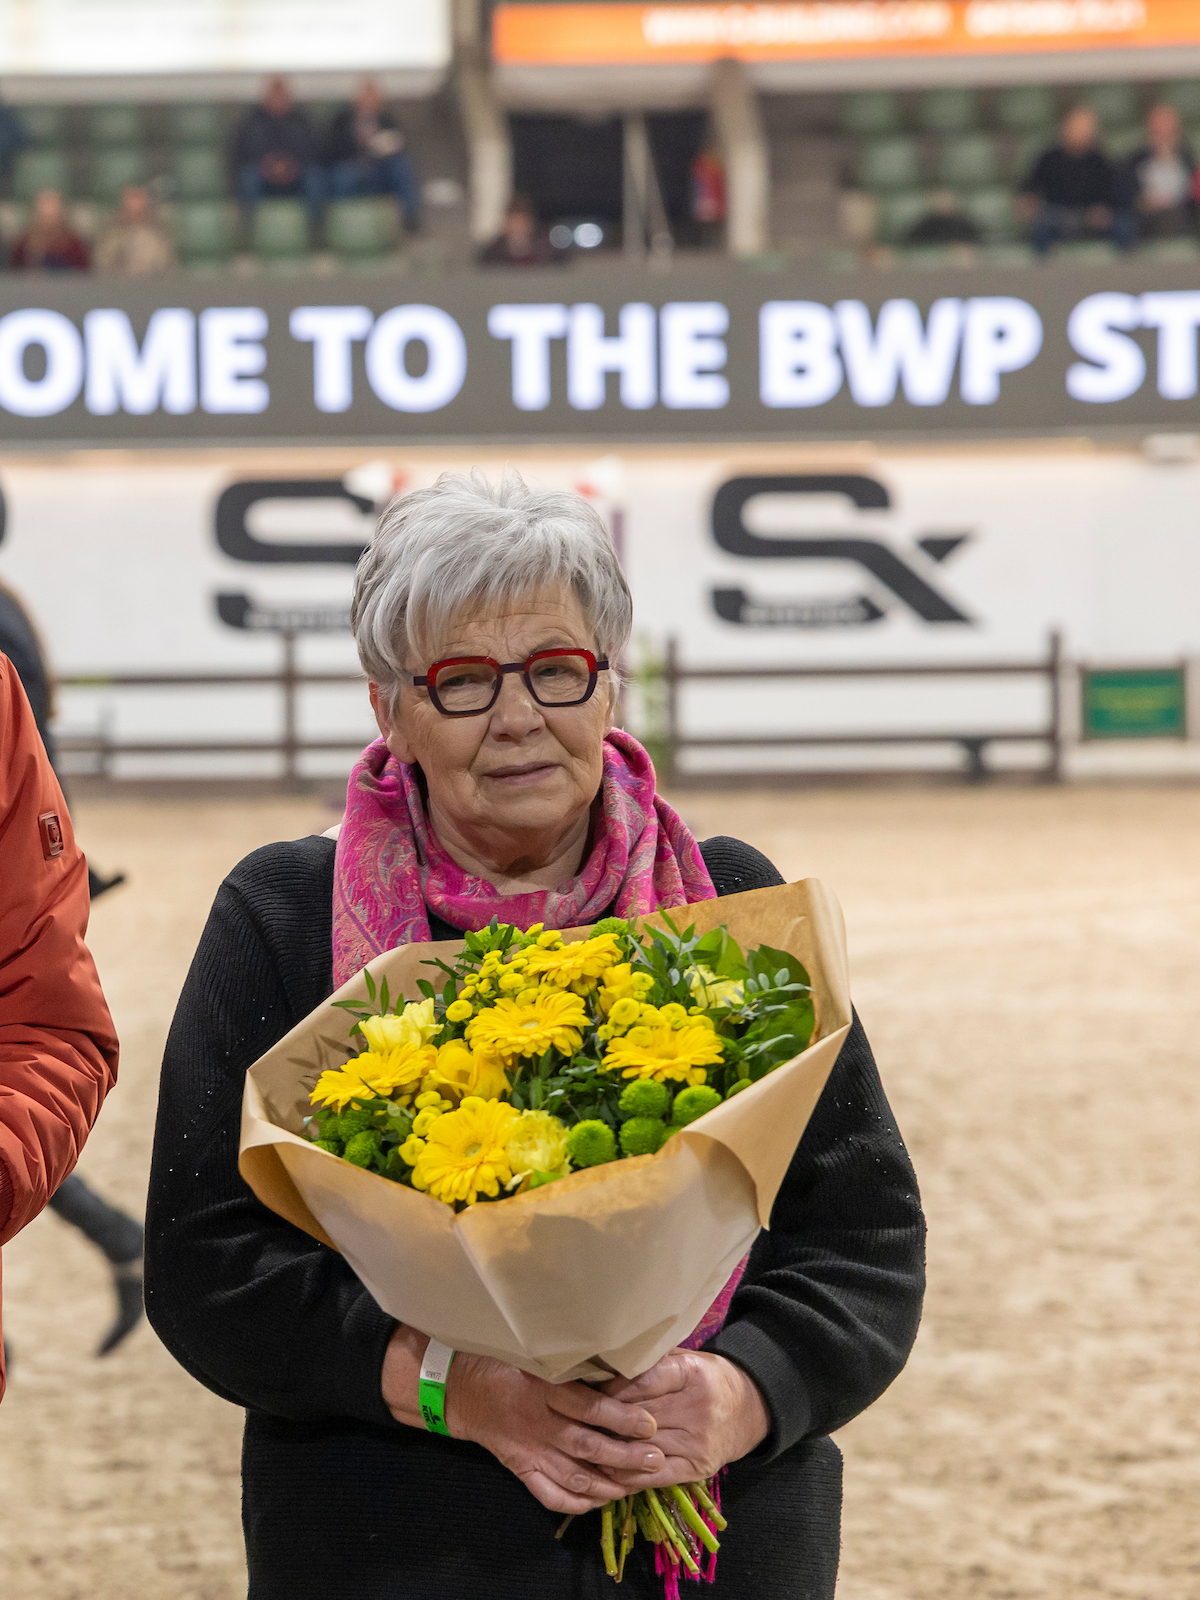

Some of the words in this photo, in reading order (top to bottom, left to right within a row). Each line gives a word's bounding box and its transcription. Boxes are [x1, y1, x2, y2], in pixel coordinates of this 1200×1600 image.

[290, 303, 467, 414] TO
[488, 301, 730, 412] THE
[758, 296, 1043, 409] BWP
[1066, 290, 1200, 404] ST
